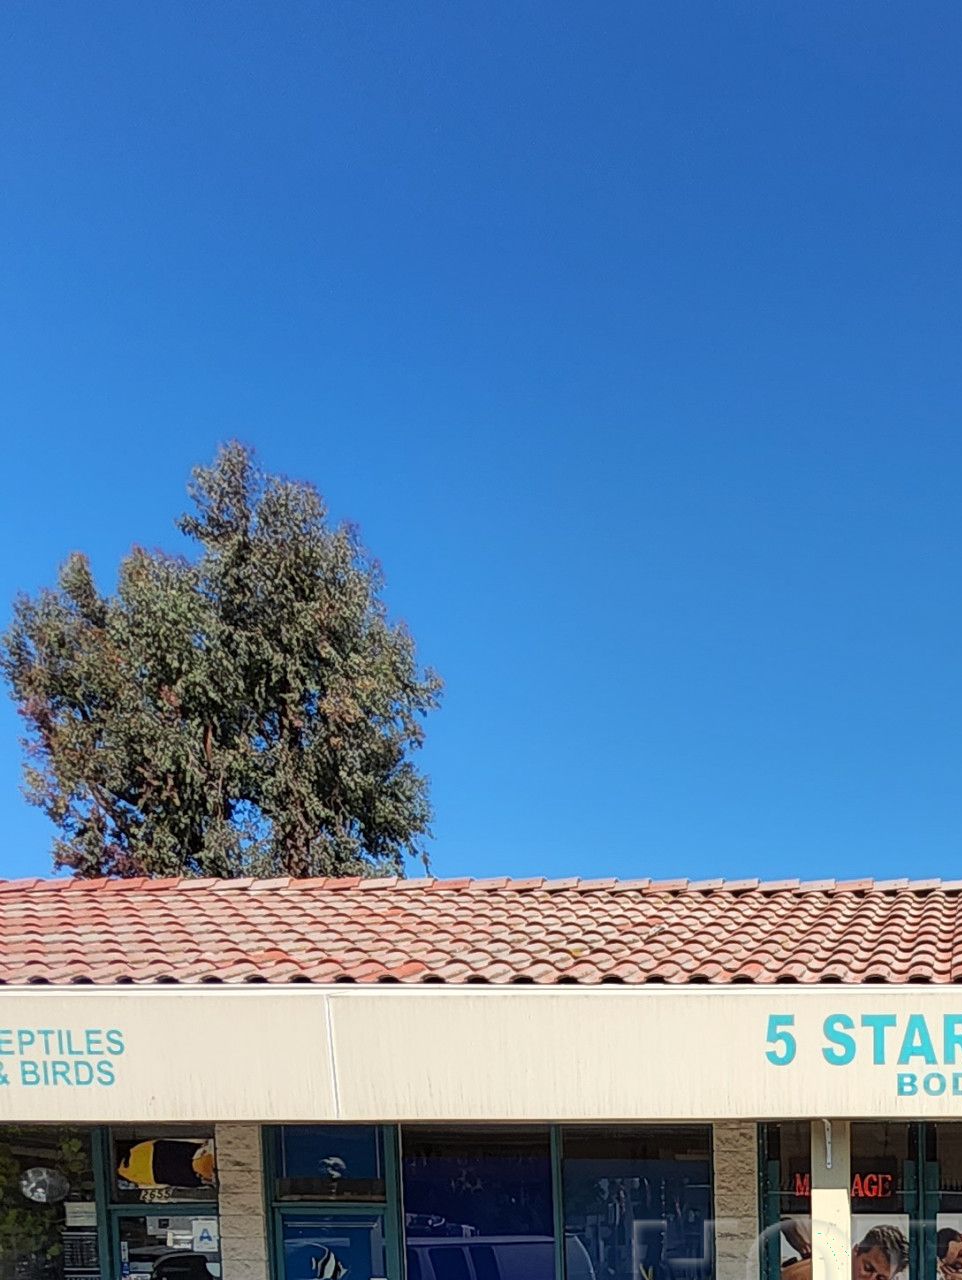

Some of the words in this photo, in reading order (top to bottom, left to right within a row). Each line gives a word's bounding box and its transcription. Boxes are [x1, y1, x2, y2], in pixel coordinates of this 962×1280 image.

[0, 1029, 125, 1056] EPTILES
[765, 1014, 797, 1066] 5
[20, 1060, 116, 1086] BIRDS
[795, 1173, 893, 1198] MAGE
[199, 1228, 213, 1242] A
